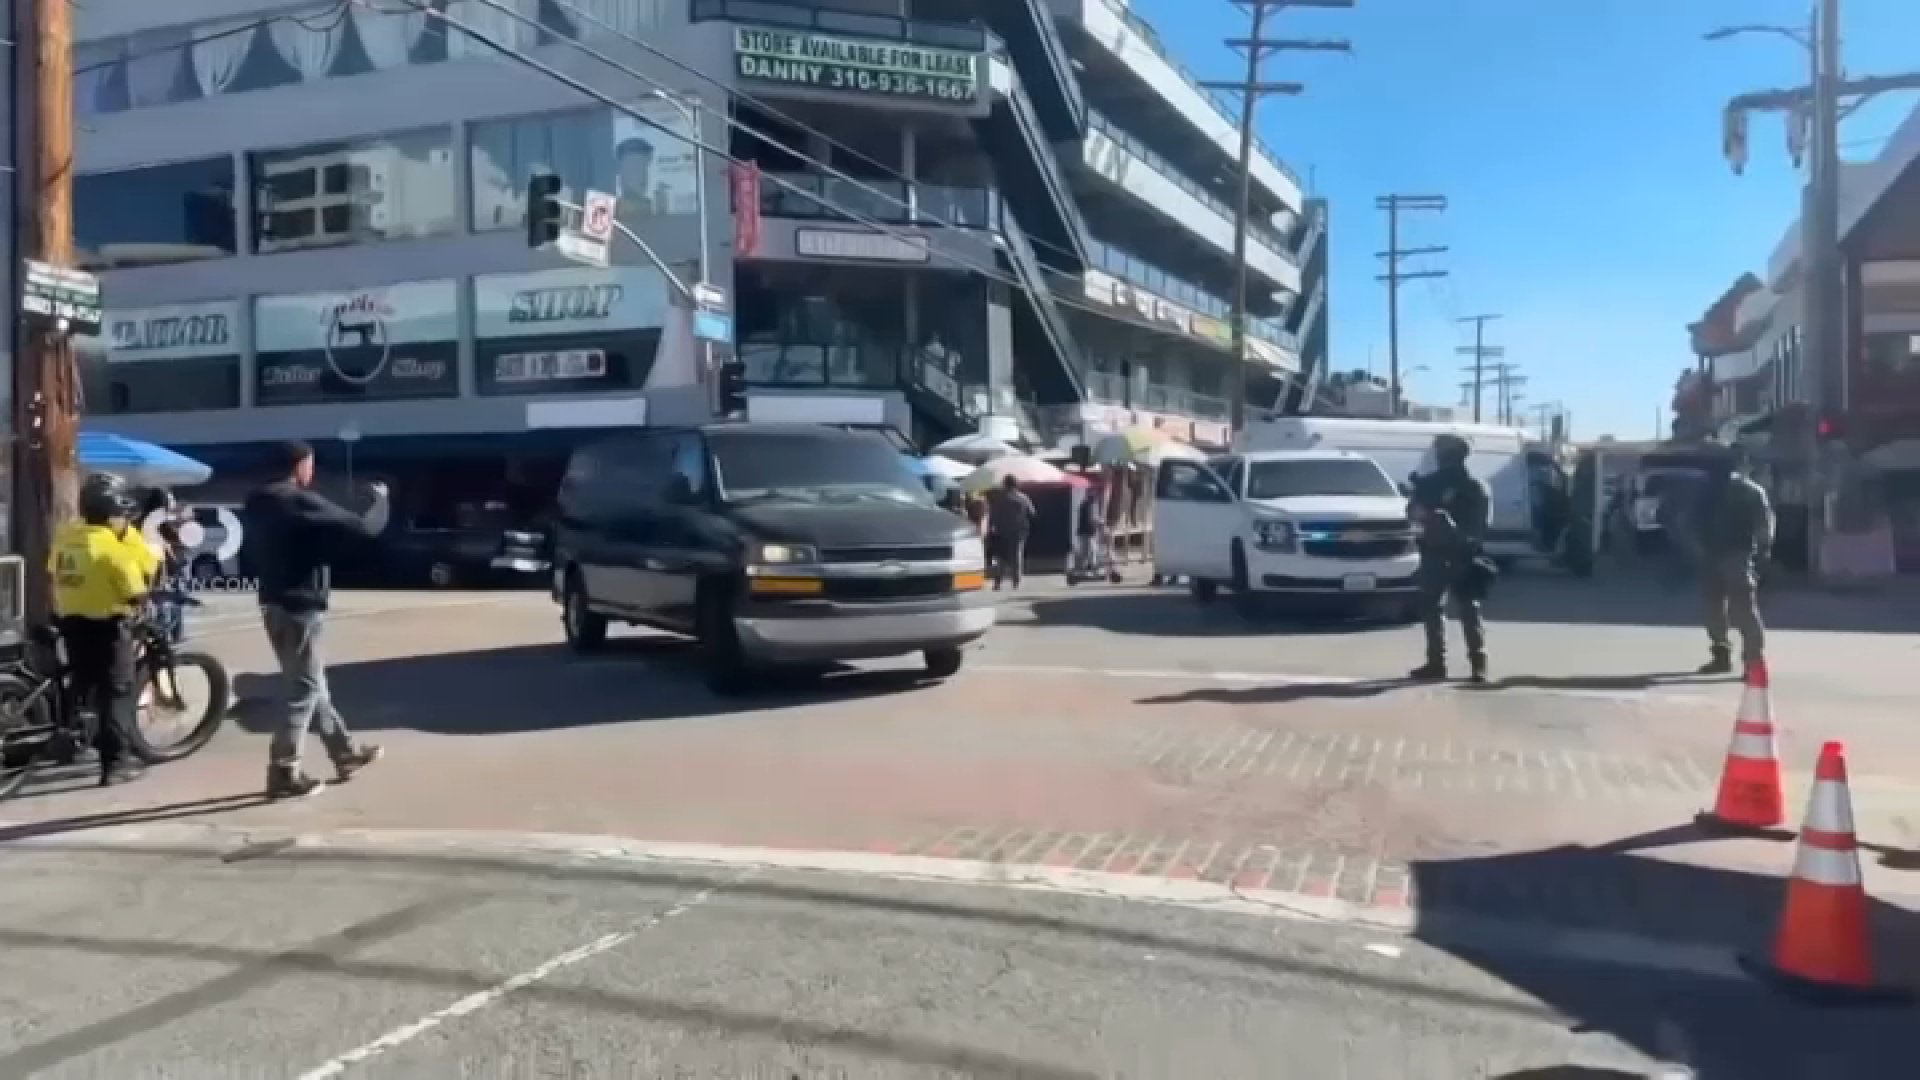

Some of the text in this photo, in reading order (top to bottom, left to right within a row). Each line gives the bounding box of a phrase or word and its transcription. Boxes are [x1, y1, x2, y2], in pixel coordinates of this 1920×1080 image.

[739, 28, 794, 54] STORE
[799, 36, 889, 64] AVAILABLE
[740, 55, 823, 83] DANNY
[509, 284, 623, 322] SHOP
